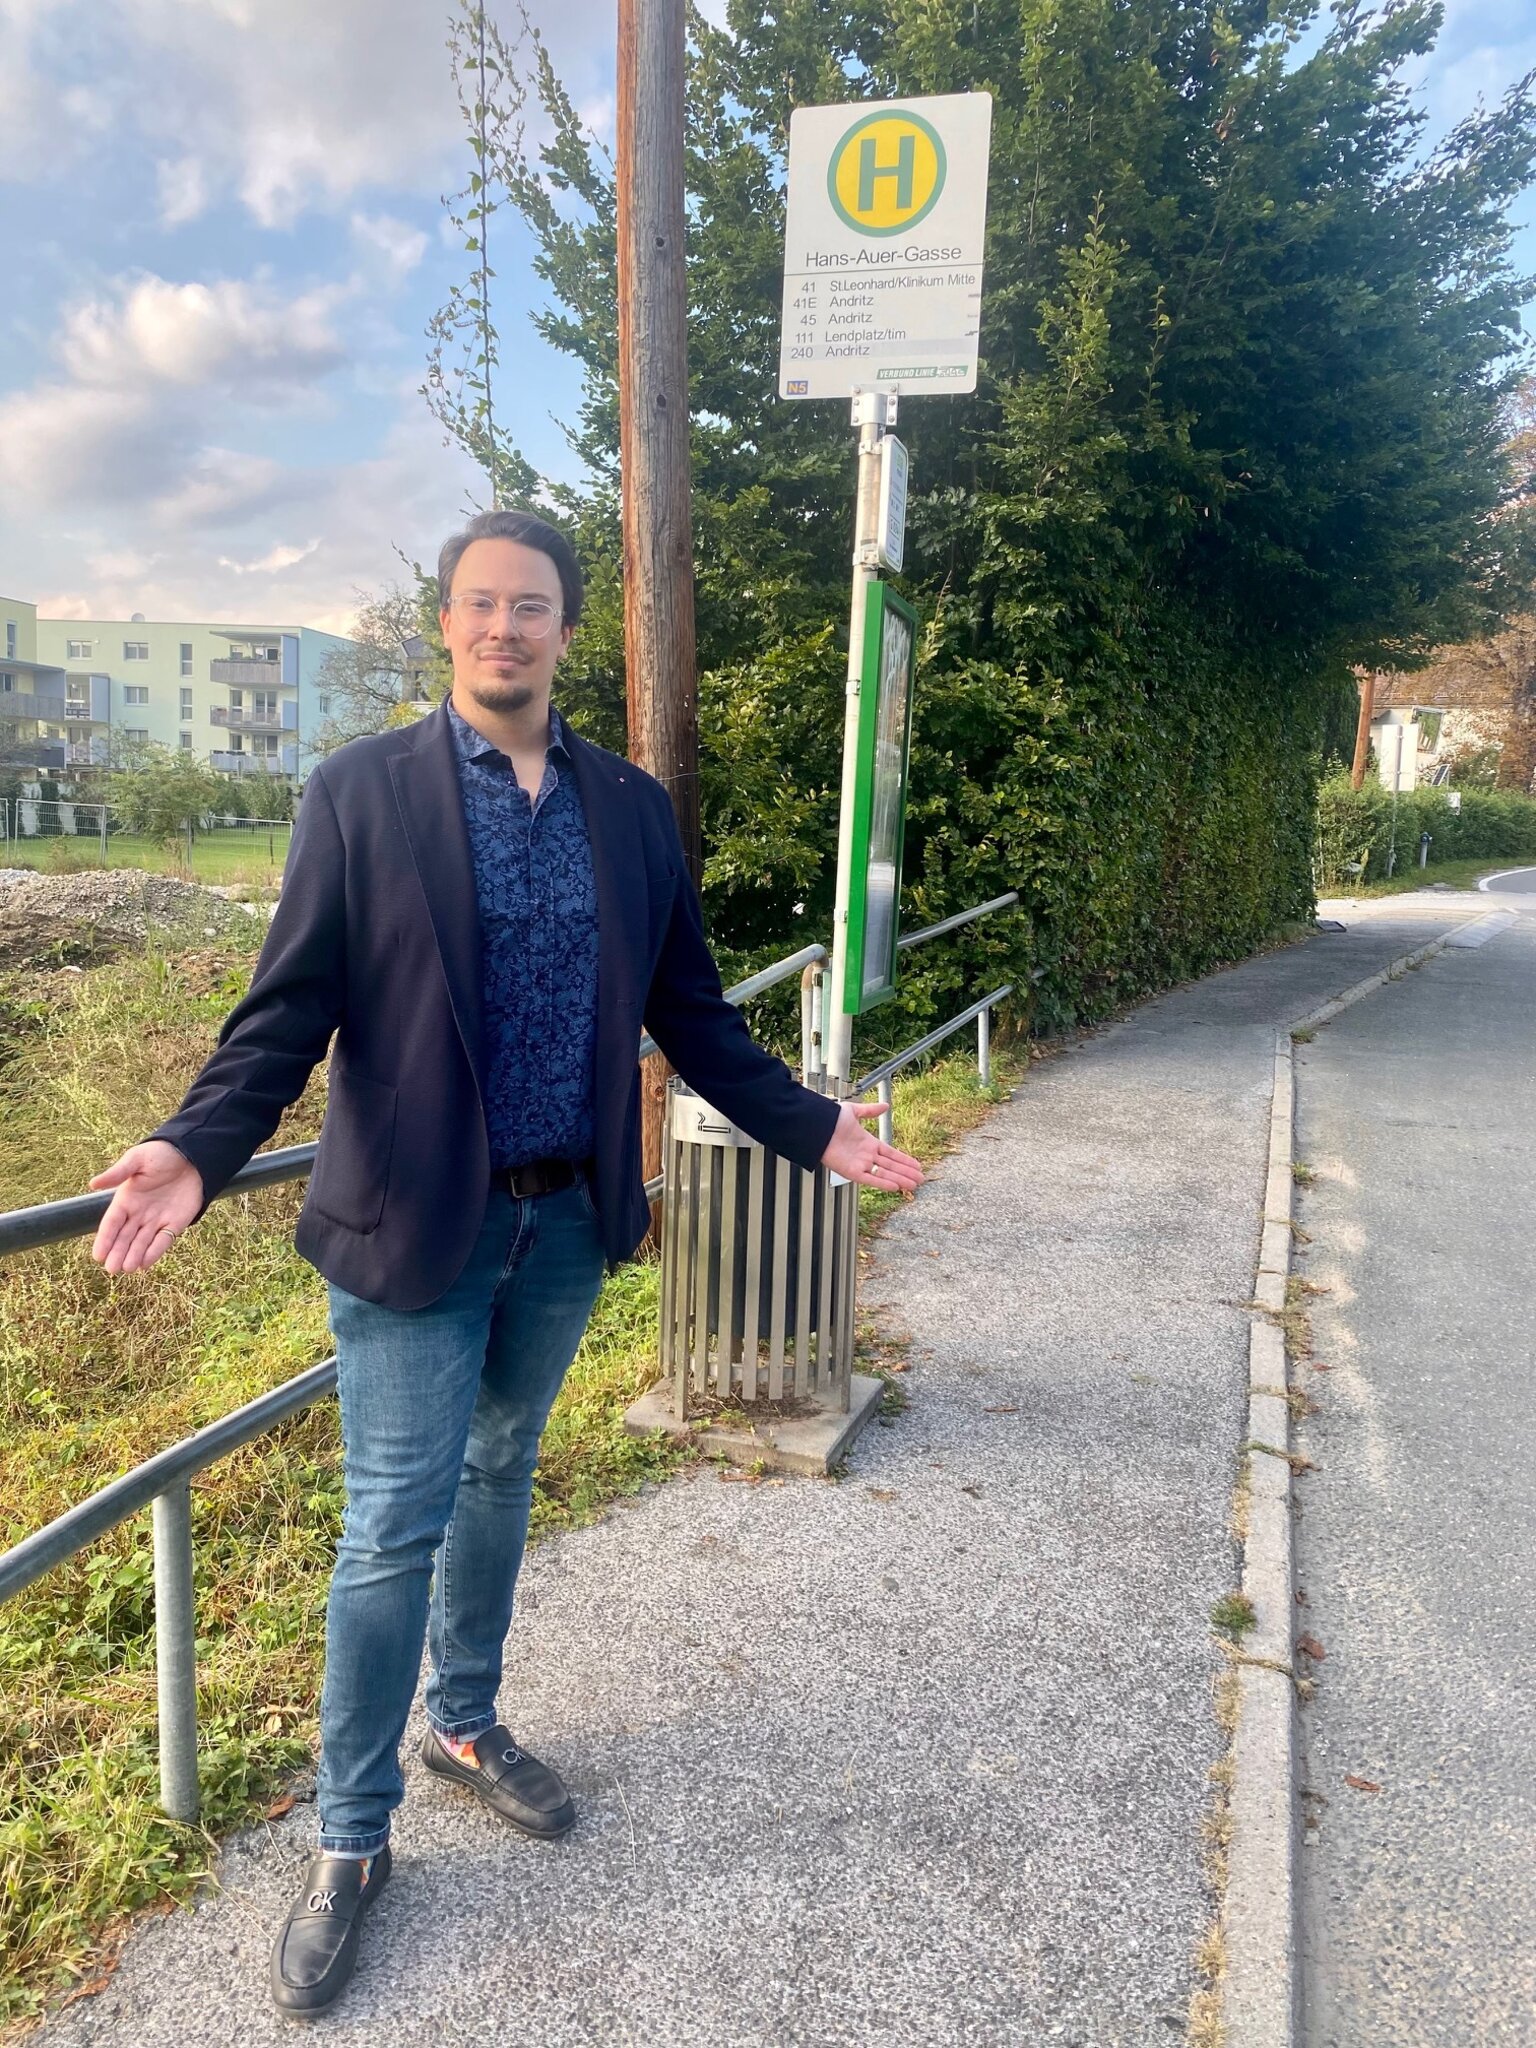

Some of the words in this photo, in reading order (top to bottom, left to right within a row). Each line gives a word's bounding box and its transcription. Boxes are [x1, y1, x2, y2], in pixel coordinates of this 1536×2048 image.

[858, 135, 915, 212] H
[806, 246, 962, 268] Hans-Auer-Gasse
[801, 282, 816, 293] 41
[948, 273, 976, 287] Mitte
[793, 297, 818, 309] 41E
[829, 294, 875, 308] Andritz
[800, 315, 817, 326] 45
[828, 312, 873, 325] Andritz
[795, 332, 814, 344] 111
[825, 329, 906, 344] Lendplatz/tim
[791, 348, 814, 360] 240
[825, 345, 871, 358] Andritz
[879, 369, 914, 379] VERBUND
[915, 367, 936, 377] LINIE
[788, 382, 806, 394] N5
[502, 1748, 527, 1765] CK
[306, 1891, 338, 1913] CK
